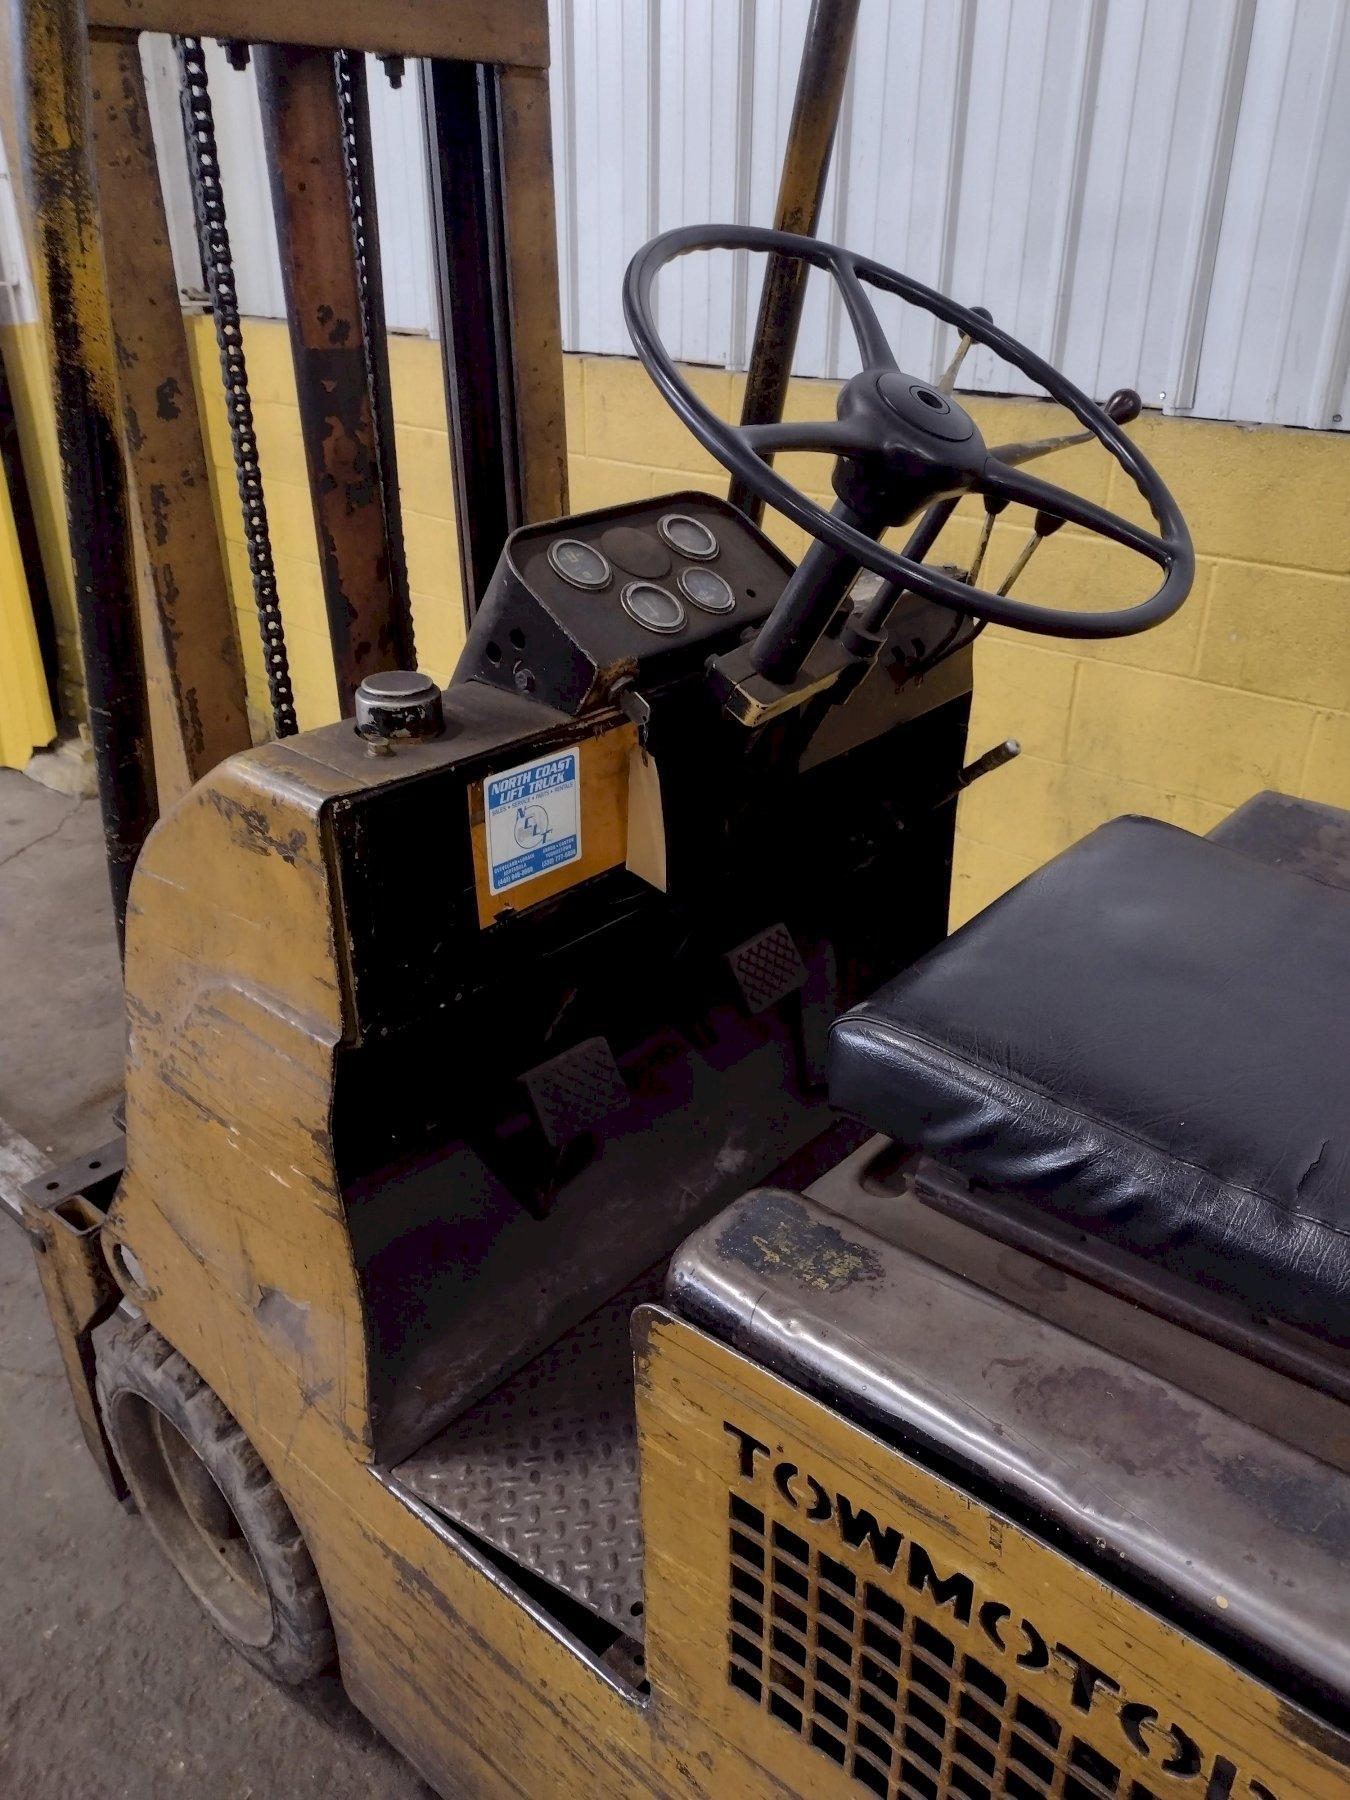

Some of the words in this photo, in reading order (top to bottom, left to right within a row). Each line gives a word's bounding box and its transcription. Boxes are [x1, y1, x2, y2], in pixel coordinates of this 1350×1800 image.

[491, 770, 532, 795] NORTH
[535, 758, 573, 781] COAST
[500, 786, 527, 804] LIFT
[529, 771, 566, 793] TRUCK
